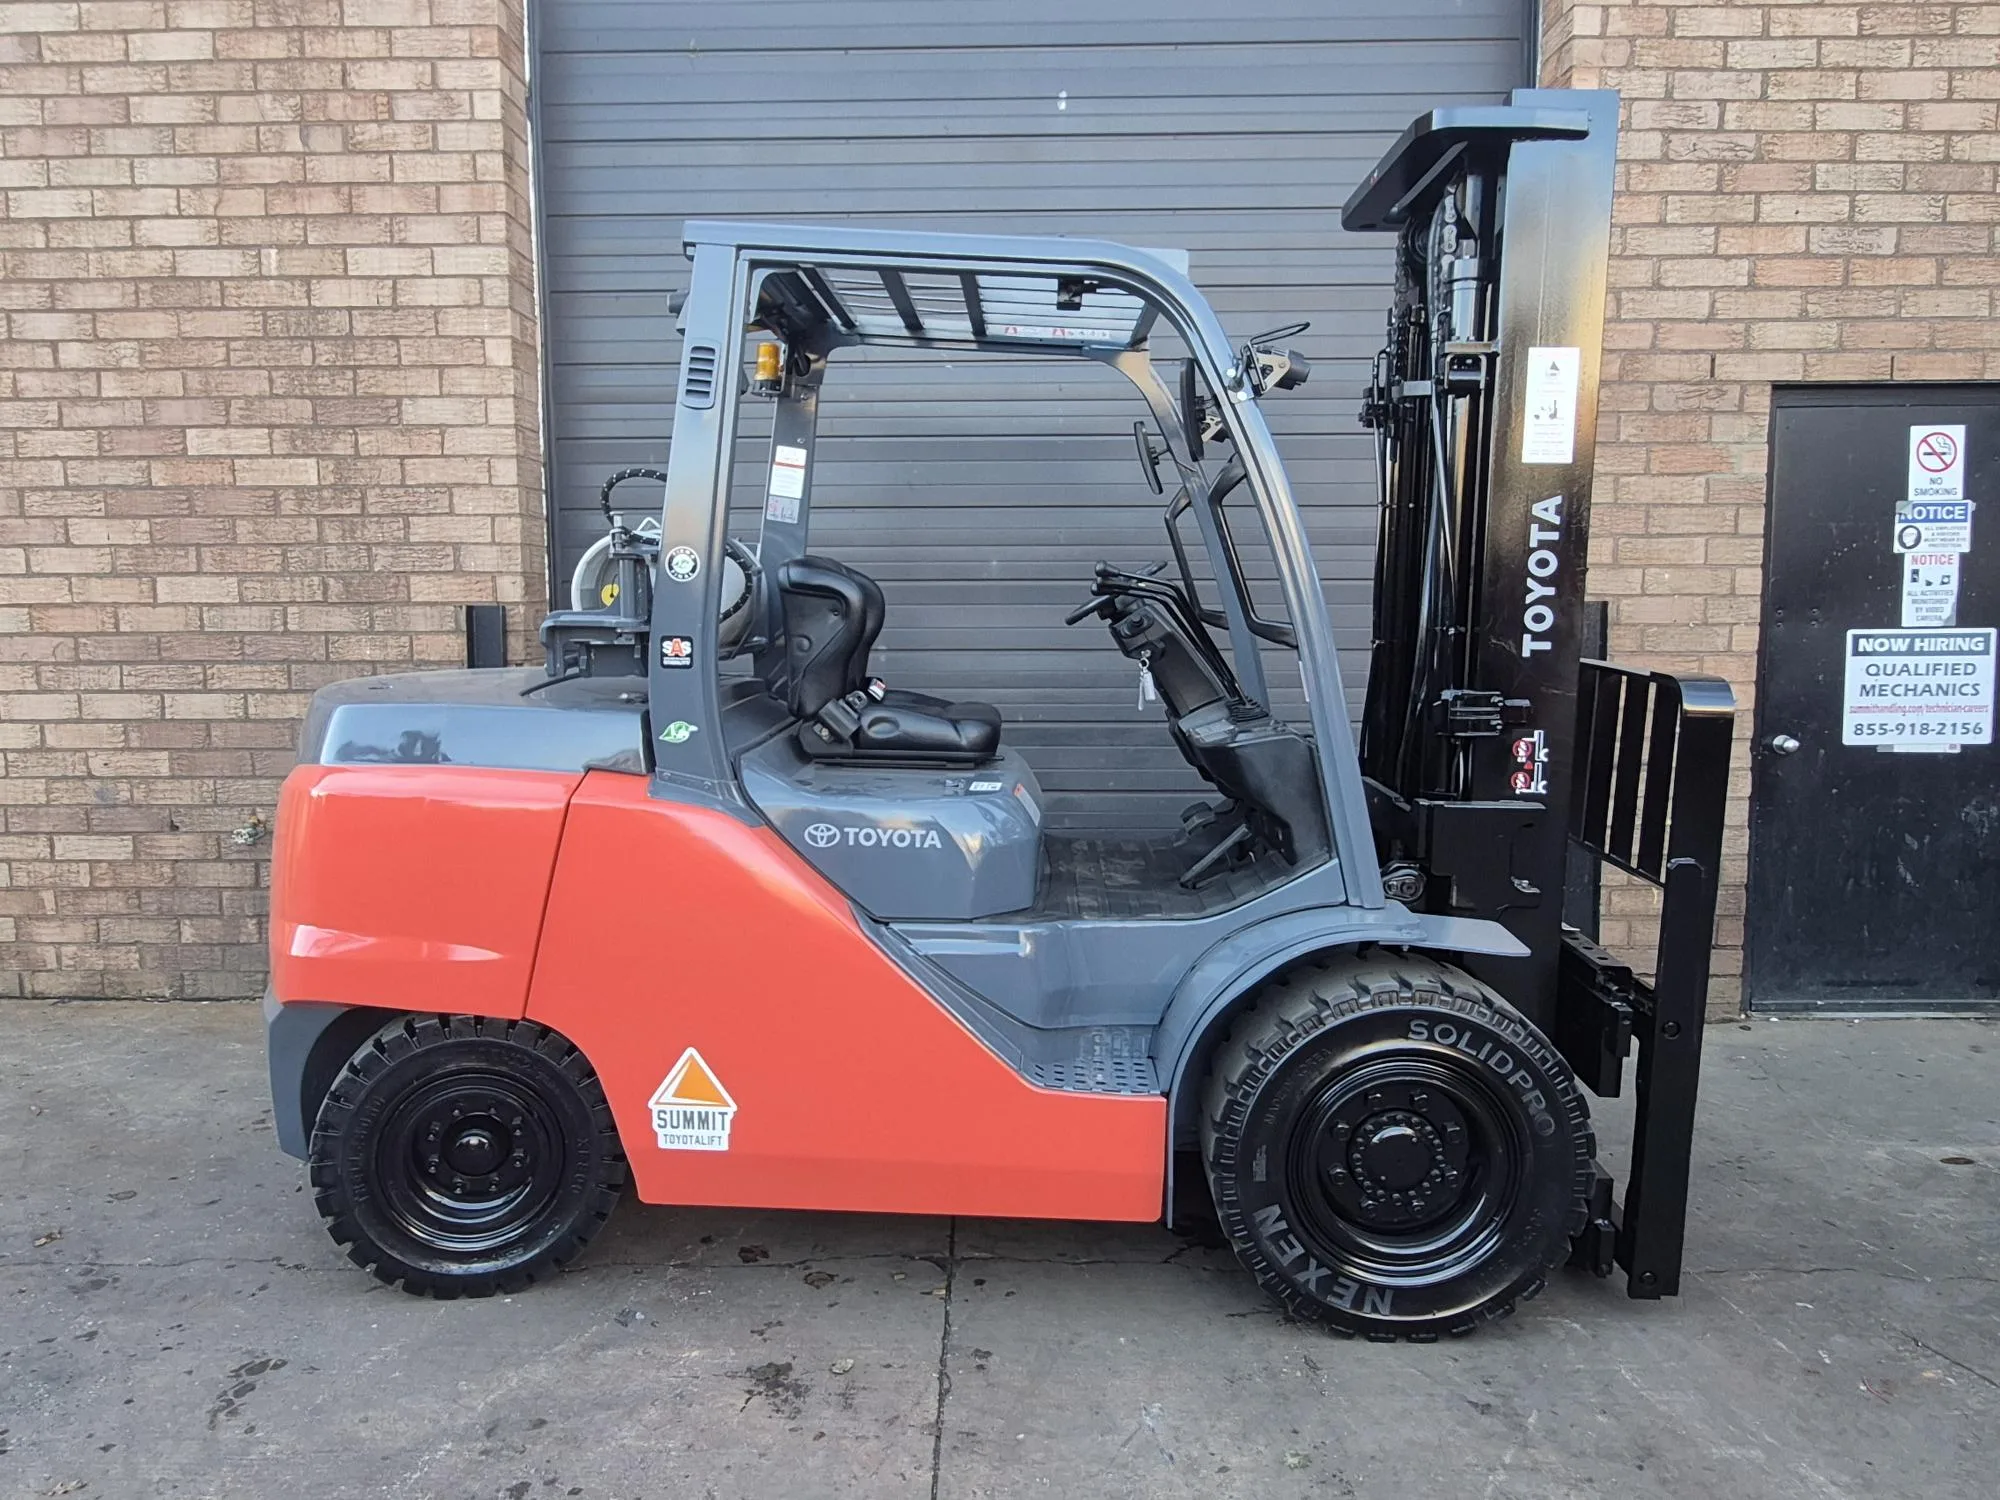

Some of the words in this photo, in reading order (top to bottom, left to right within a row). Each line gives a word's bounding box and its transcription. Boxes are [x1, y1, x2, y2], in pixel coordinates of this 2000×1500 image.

[1929, 477, 1943, 486] NO
[1913, 488, 1958, 496] SMOKING
[1911, 554, 1954, 565] NOTICE
[1521, 495, 1562, 658] TOYOTA
[662, 638, 692, 657] SAS
[1858, 638, 1912, 652] NOW
[1913, 637, 1985, 651] HIRING
[1865, 663, 1977, 676] QUALIFIED
[1859, 683, 1981, 697] MECHANICS
[1854, 722, 1983, 736] 855-918-2156
[843, 827, 942, 849] TOYOTA
[1408, 1019, 1556, 1136] SOLIDPRO
[657, 1109, 728, 1131] SUMMIT
[663, 1134, 722, 1146] TOYOTALIFT
[1252, 1204, 1395, 1316] NEXEN
